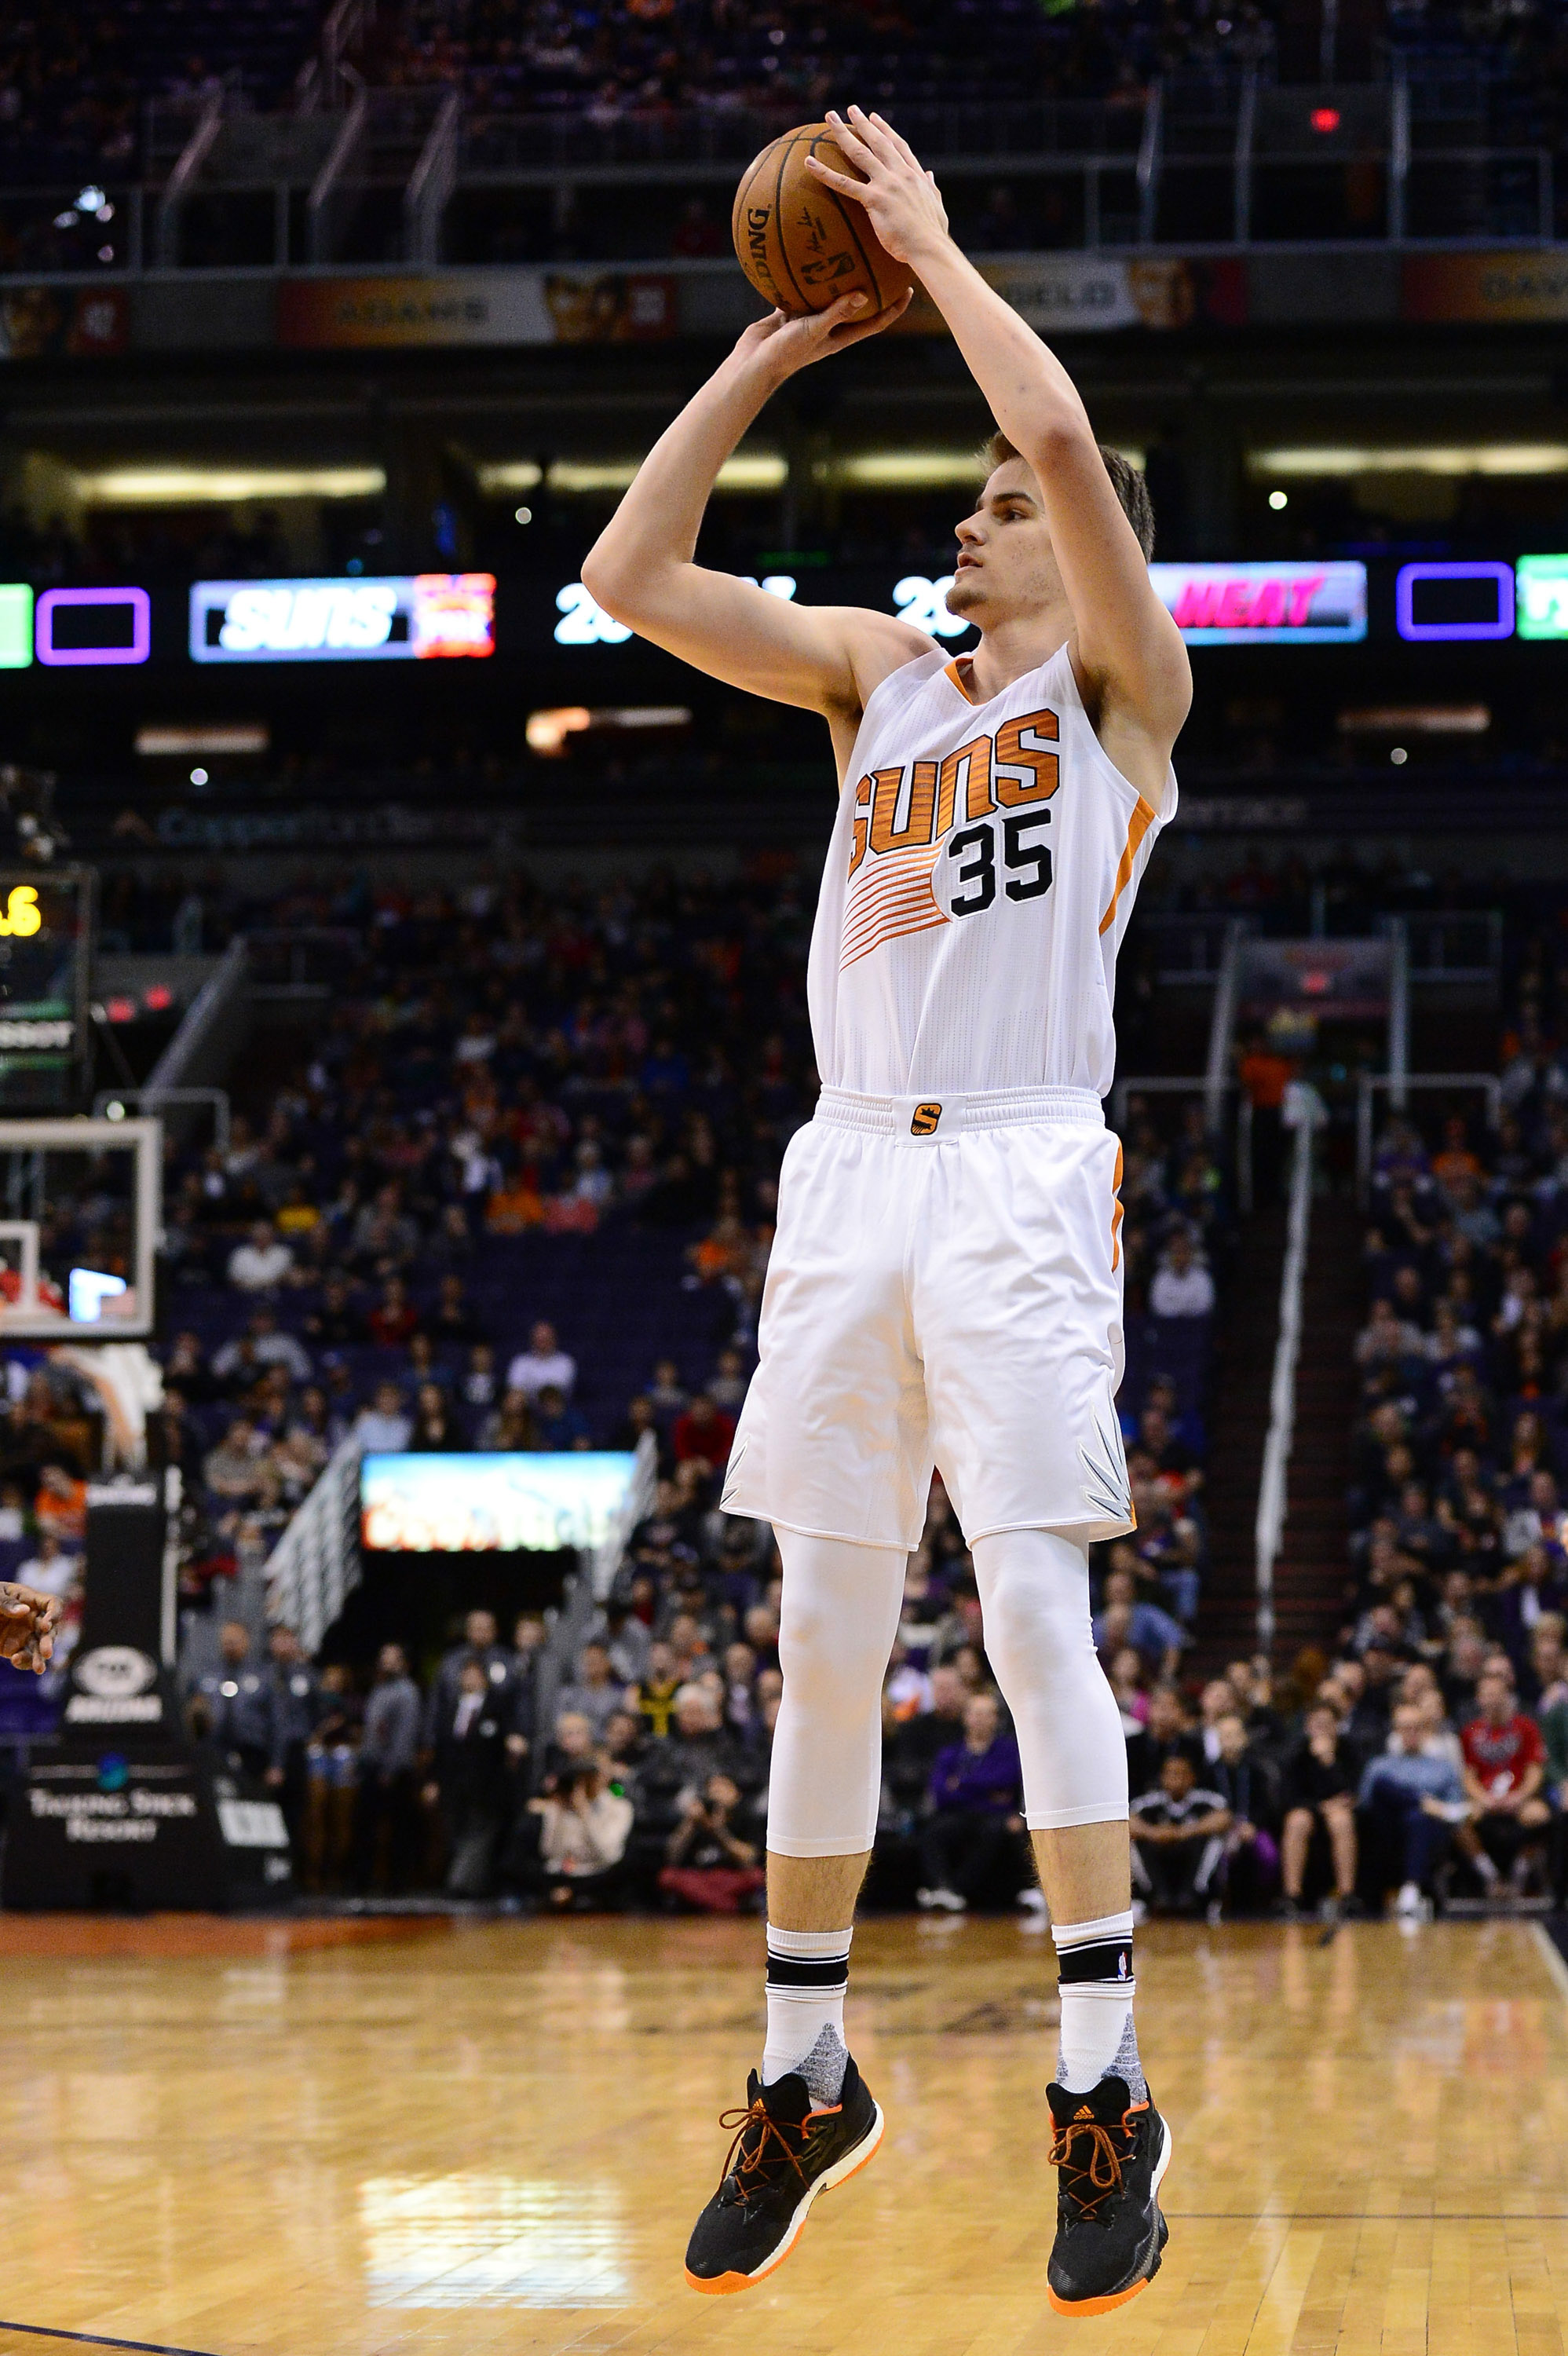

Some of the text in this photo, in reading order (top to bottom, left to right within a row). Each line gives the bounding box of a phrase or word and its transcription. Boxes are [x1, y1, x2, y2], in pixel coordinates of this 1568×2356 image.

[220, 586, 397, 650] SUNS
[1174, 567, 1324, 627] HEAT
[848, 708, 1061, 884] SUNS
[948, 807, 1054, 918] 35
